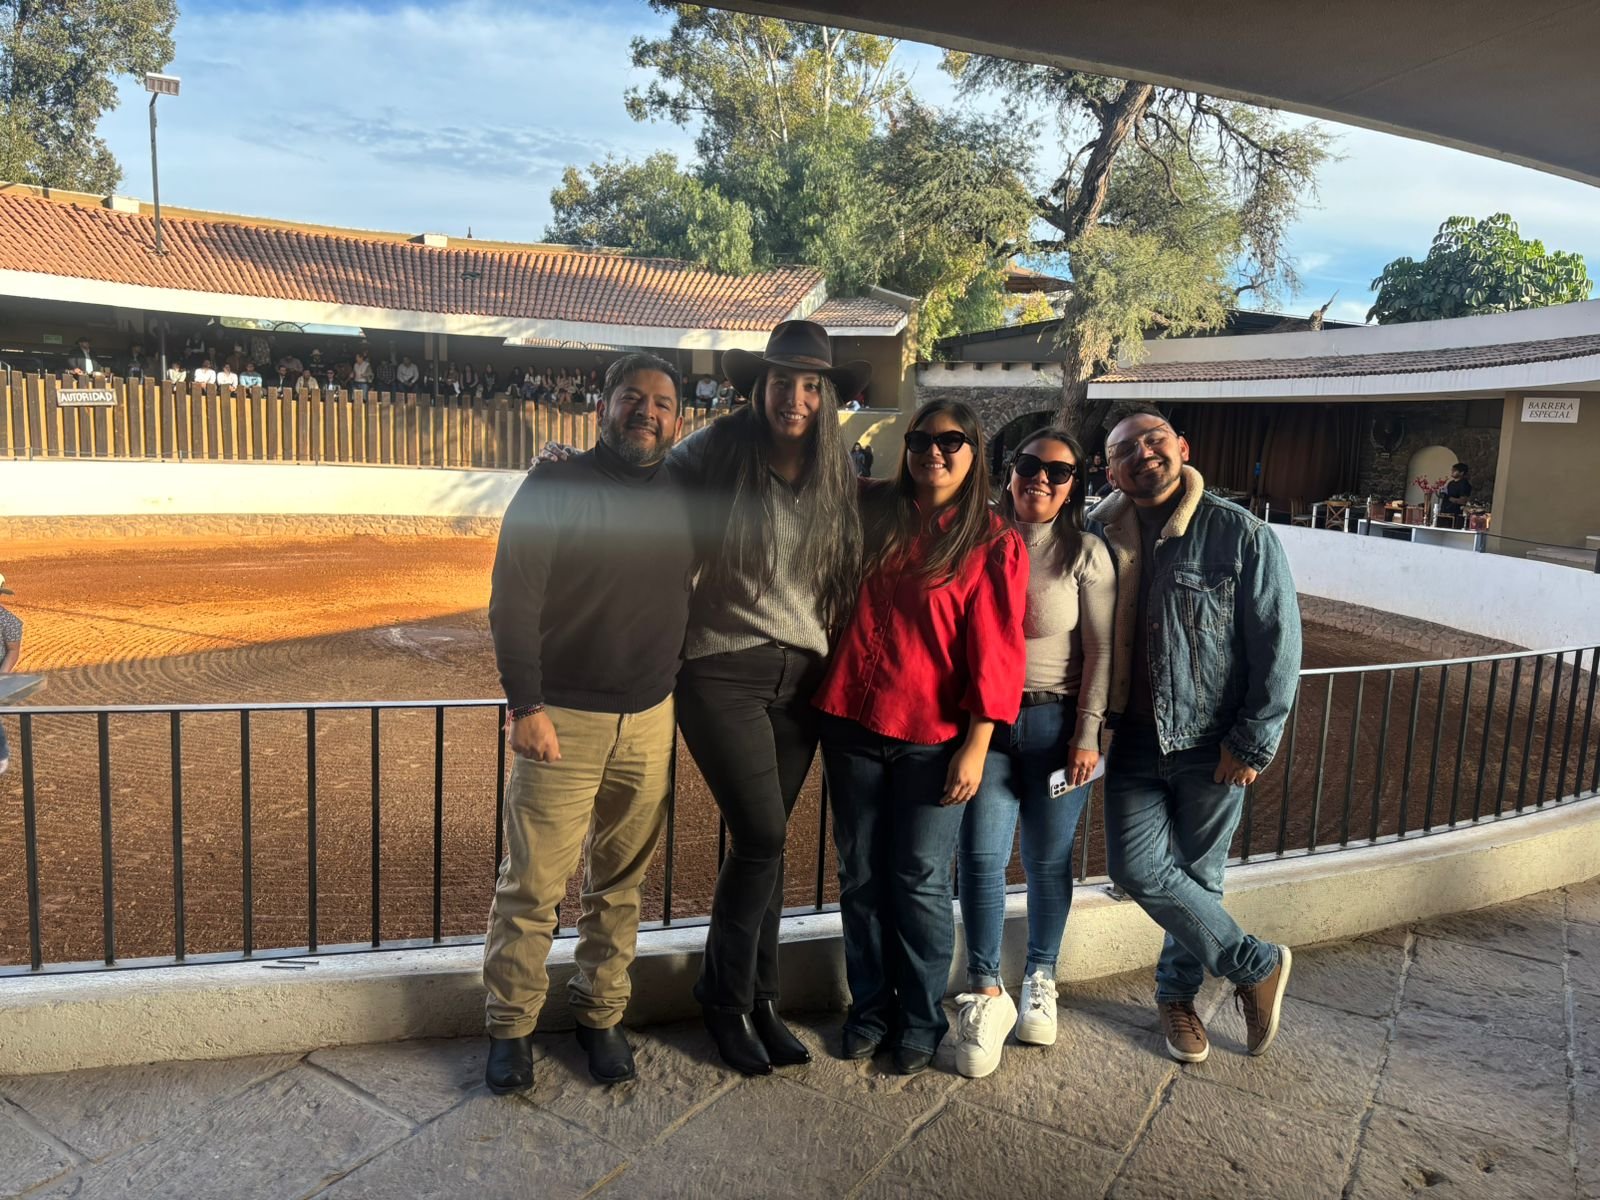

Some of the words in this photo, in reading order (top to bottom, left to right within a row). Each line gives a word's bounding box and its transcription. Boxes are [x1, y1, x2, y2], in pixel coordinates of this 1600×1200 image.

[61, 392, 112, 402] AUTORIDAD
[1528, 401, 1574, 410] BARRERA
[1529, 410, 1571, 419] ESPECIAL
